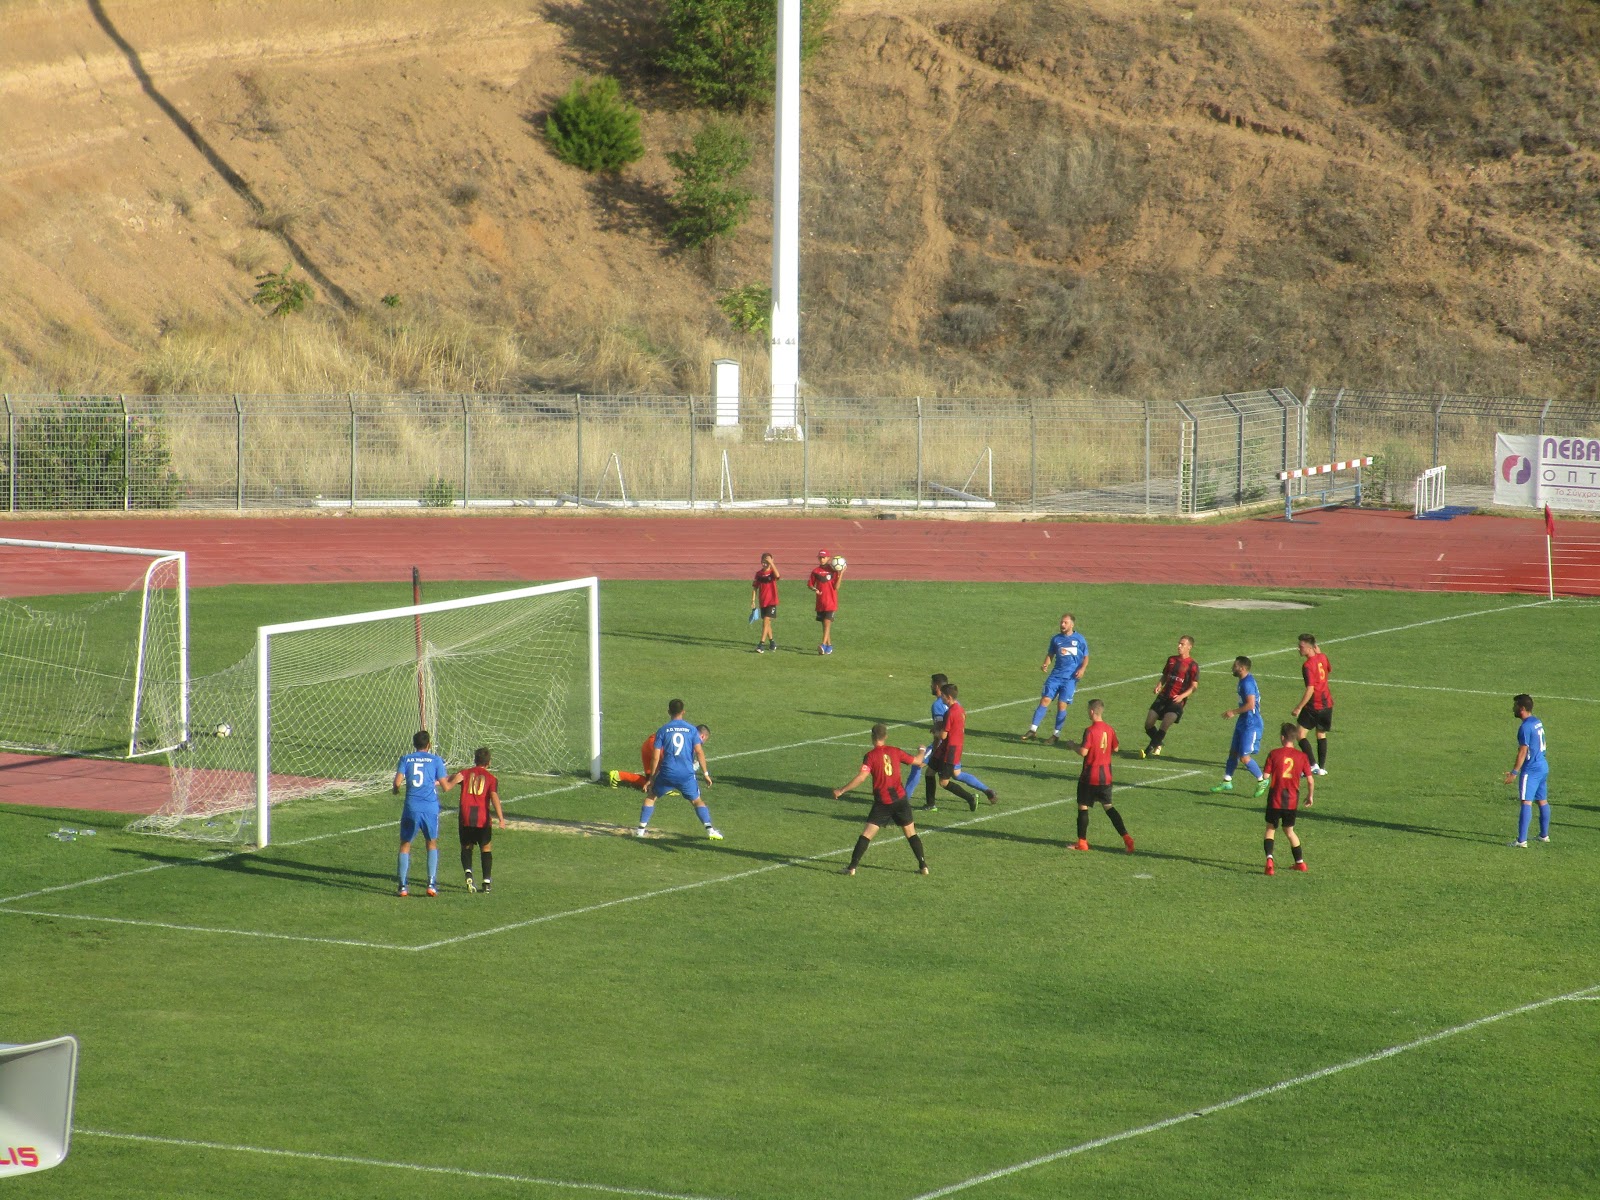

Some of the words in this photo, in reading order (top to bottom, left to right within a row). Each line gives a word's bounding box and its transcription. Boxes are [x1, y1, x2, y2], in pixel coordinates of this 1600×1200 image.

[672, 732, 684, 756] 9
[412, 763, 424, 787] 5
[883, 753, 893, 776] 8
[1282, 757, 1294, 779] 2
[468, 772, 486, 795] 10
